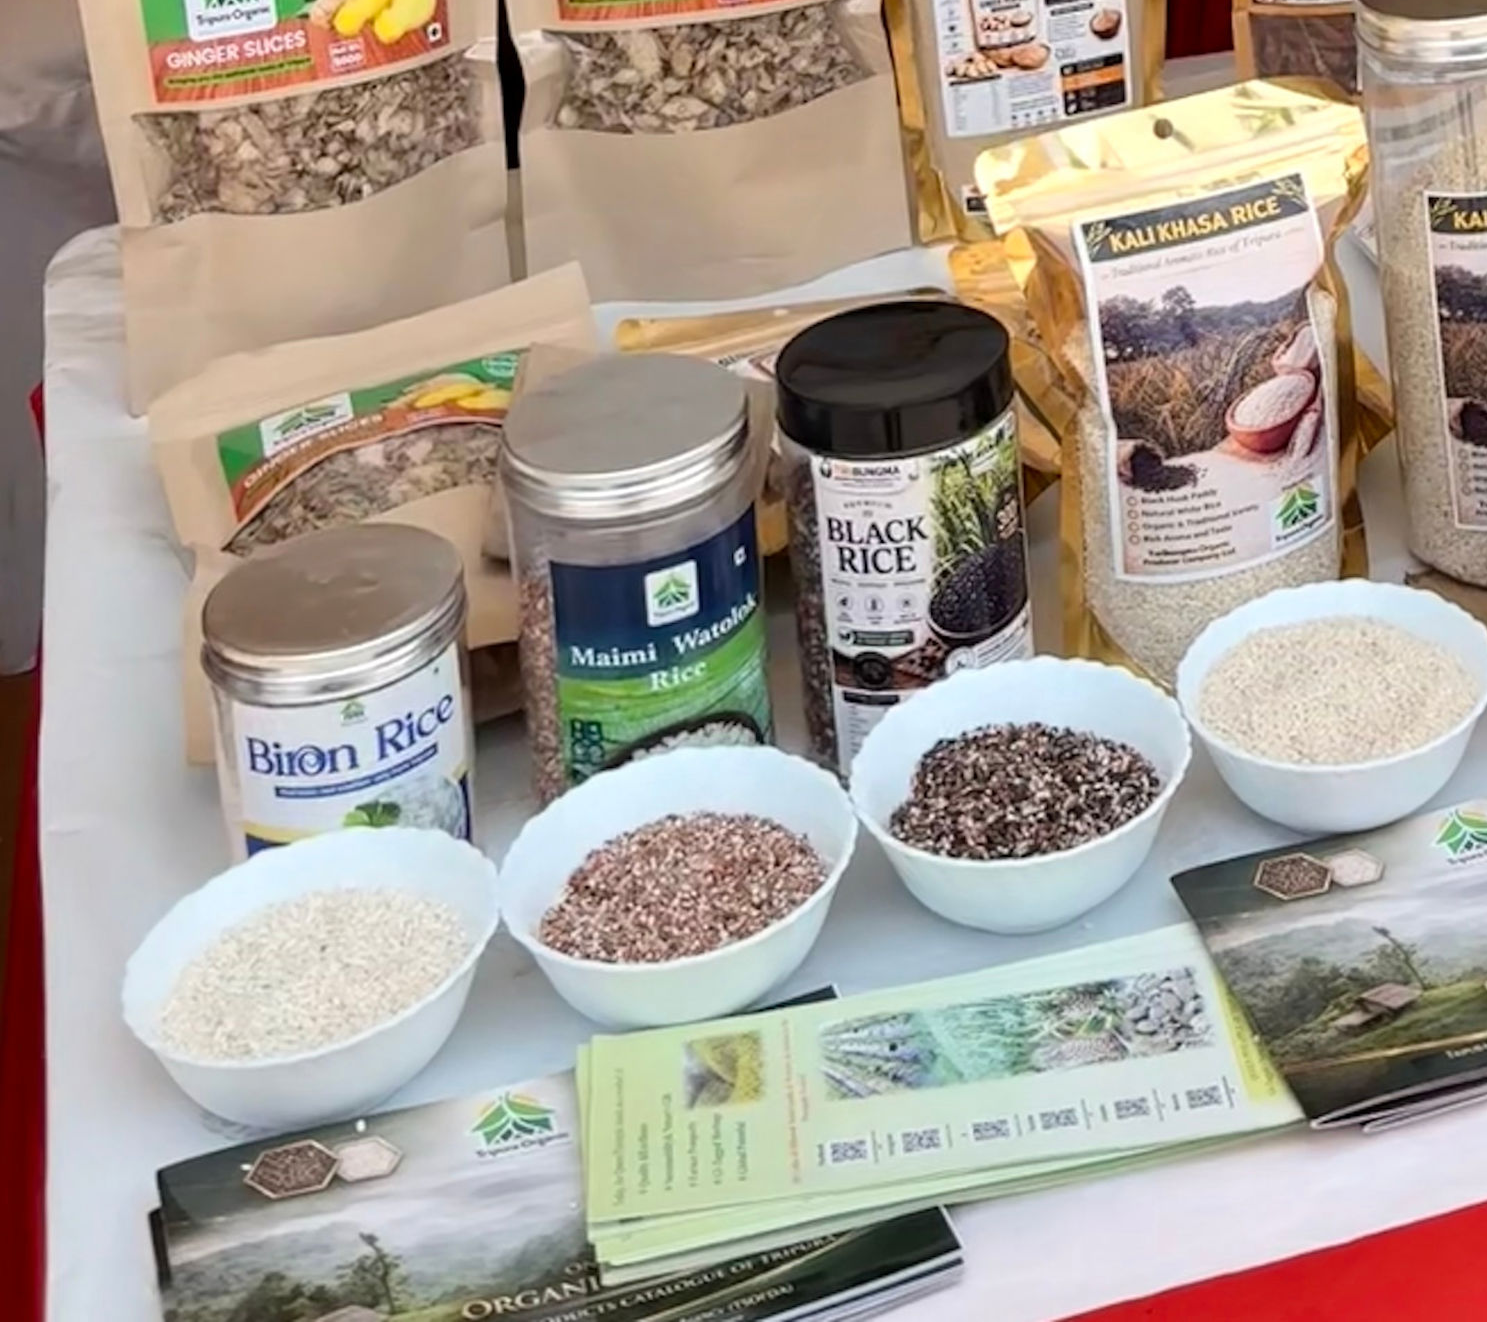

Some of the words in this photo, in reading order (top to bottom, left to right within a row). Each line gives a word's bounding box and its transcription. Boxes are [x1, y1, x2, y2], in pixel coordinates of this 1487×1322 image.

[165, 43, 241, 70] GINGER
[243, 30, 306, 60] SLICES
[1109, 228, 1157, 253] KALI
[1157, 213, 1228, 243] KHASA
[1229, 196, 1282, 226] RICE
[826, 515, 929, 546] BLACK
[836, 545, 917, 575] RICE
[570, 642, 657, 669] Maimi
[671, 592, 758, 654] Watolok
[648, 657, 708, 692] Rice
[246, 736, 360, 777] Biron
[375, 694, 455, 762] Rice
[616, 1268, 726, 1308] CATALOGUE
[730, 1259, 756, 1274] OF
[761, 1234, 839, 1266] TRIPURA
